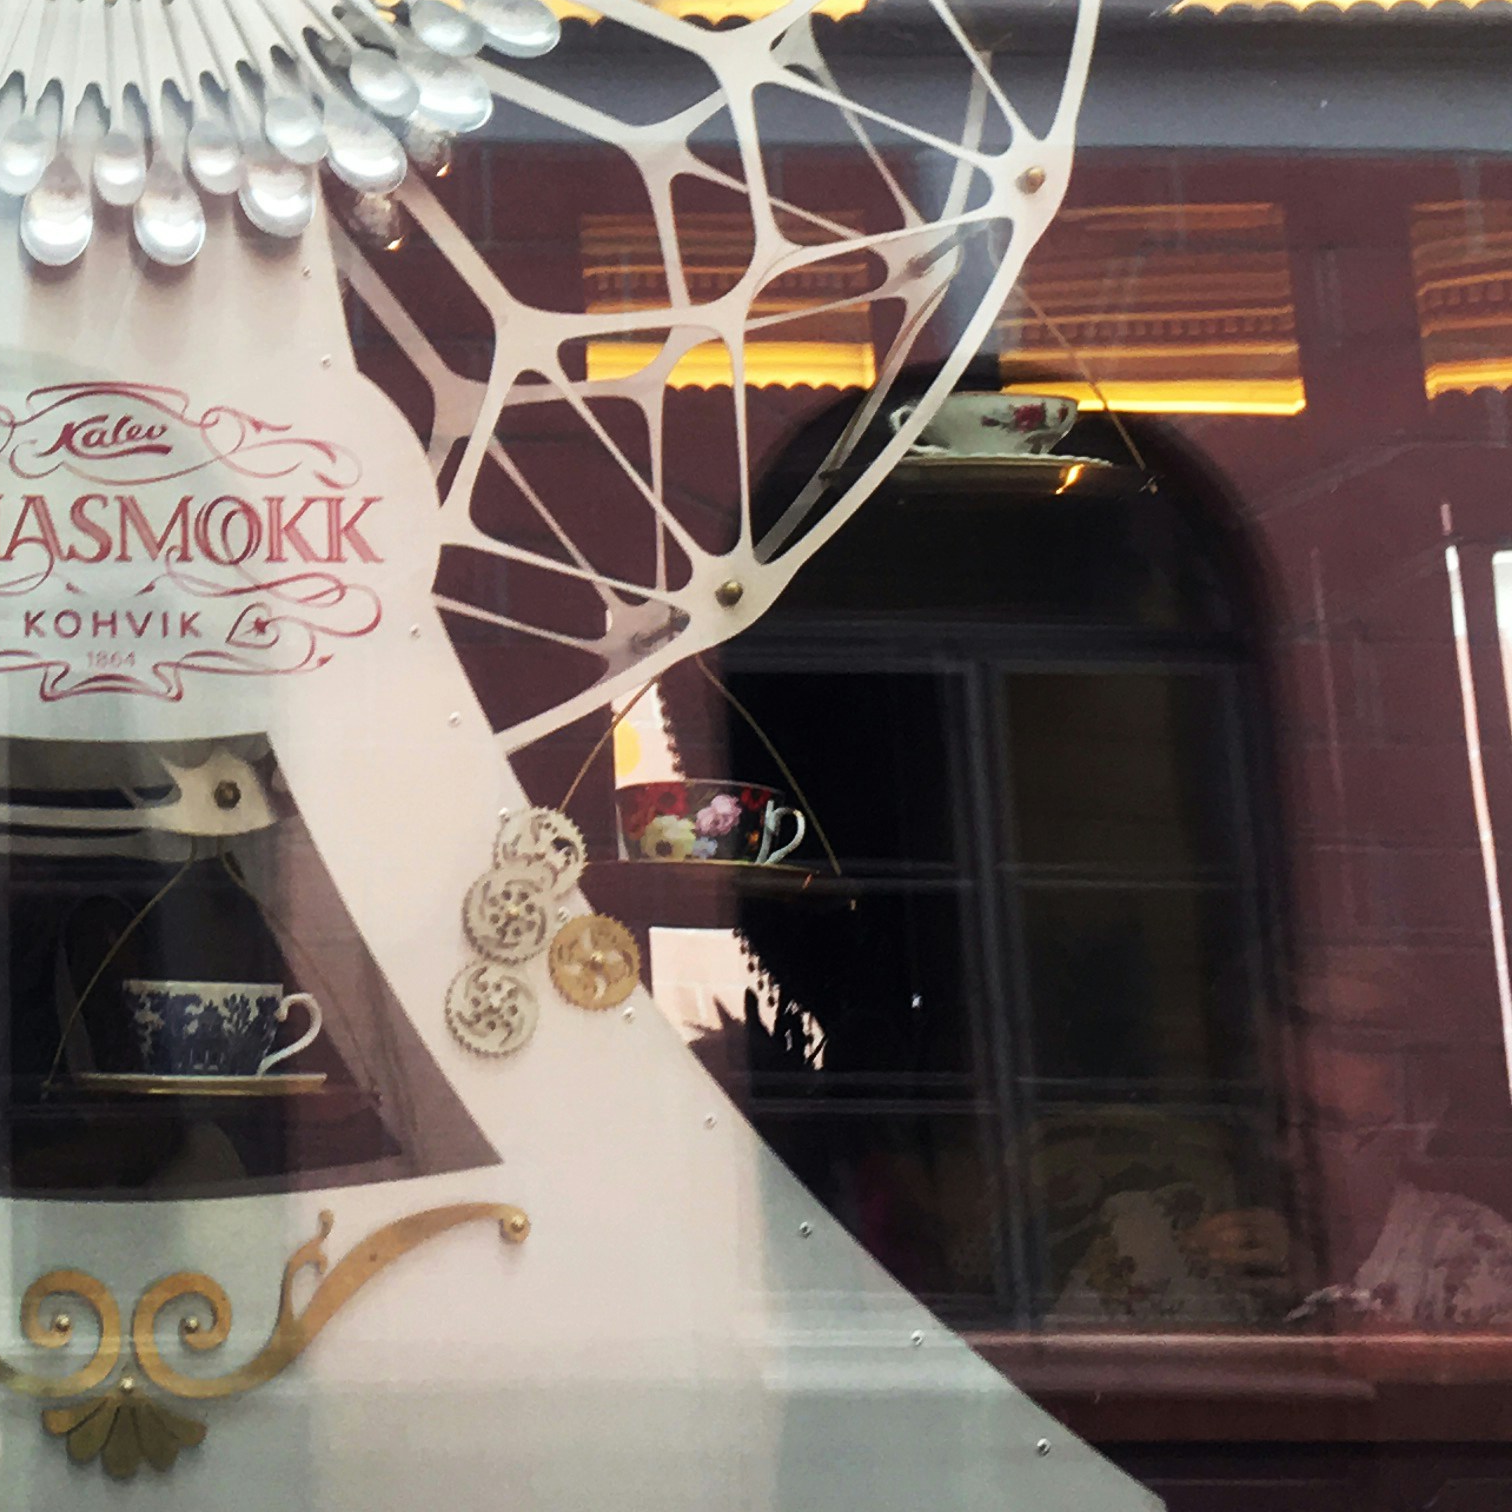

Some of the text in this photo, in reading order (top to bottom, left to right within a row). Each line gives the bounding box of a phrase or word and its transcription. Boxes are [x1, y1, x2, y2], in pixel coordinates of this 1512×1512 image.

[35, 414, 172, 460] Kalev
[23, 609, 202, 639] KOHVIK
[88, 650, 135, 668] 1864
